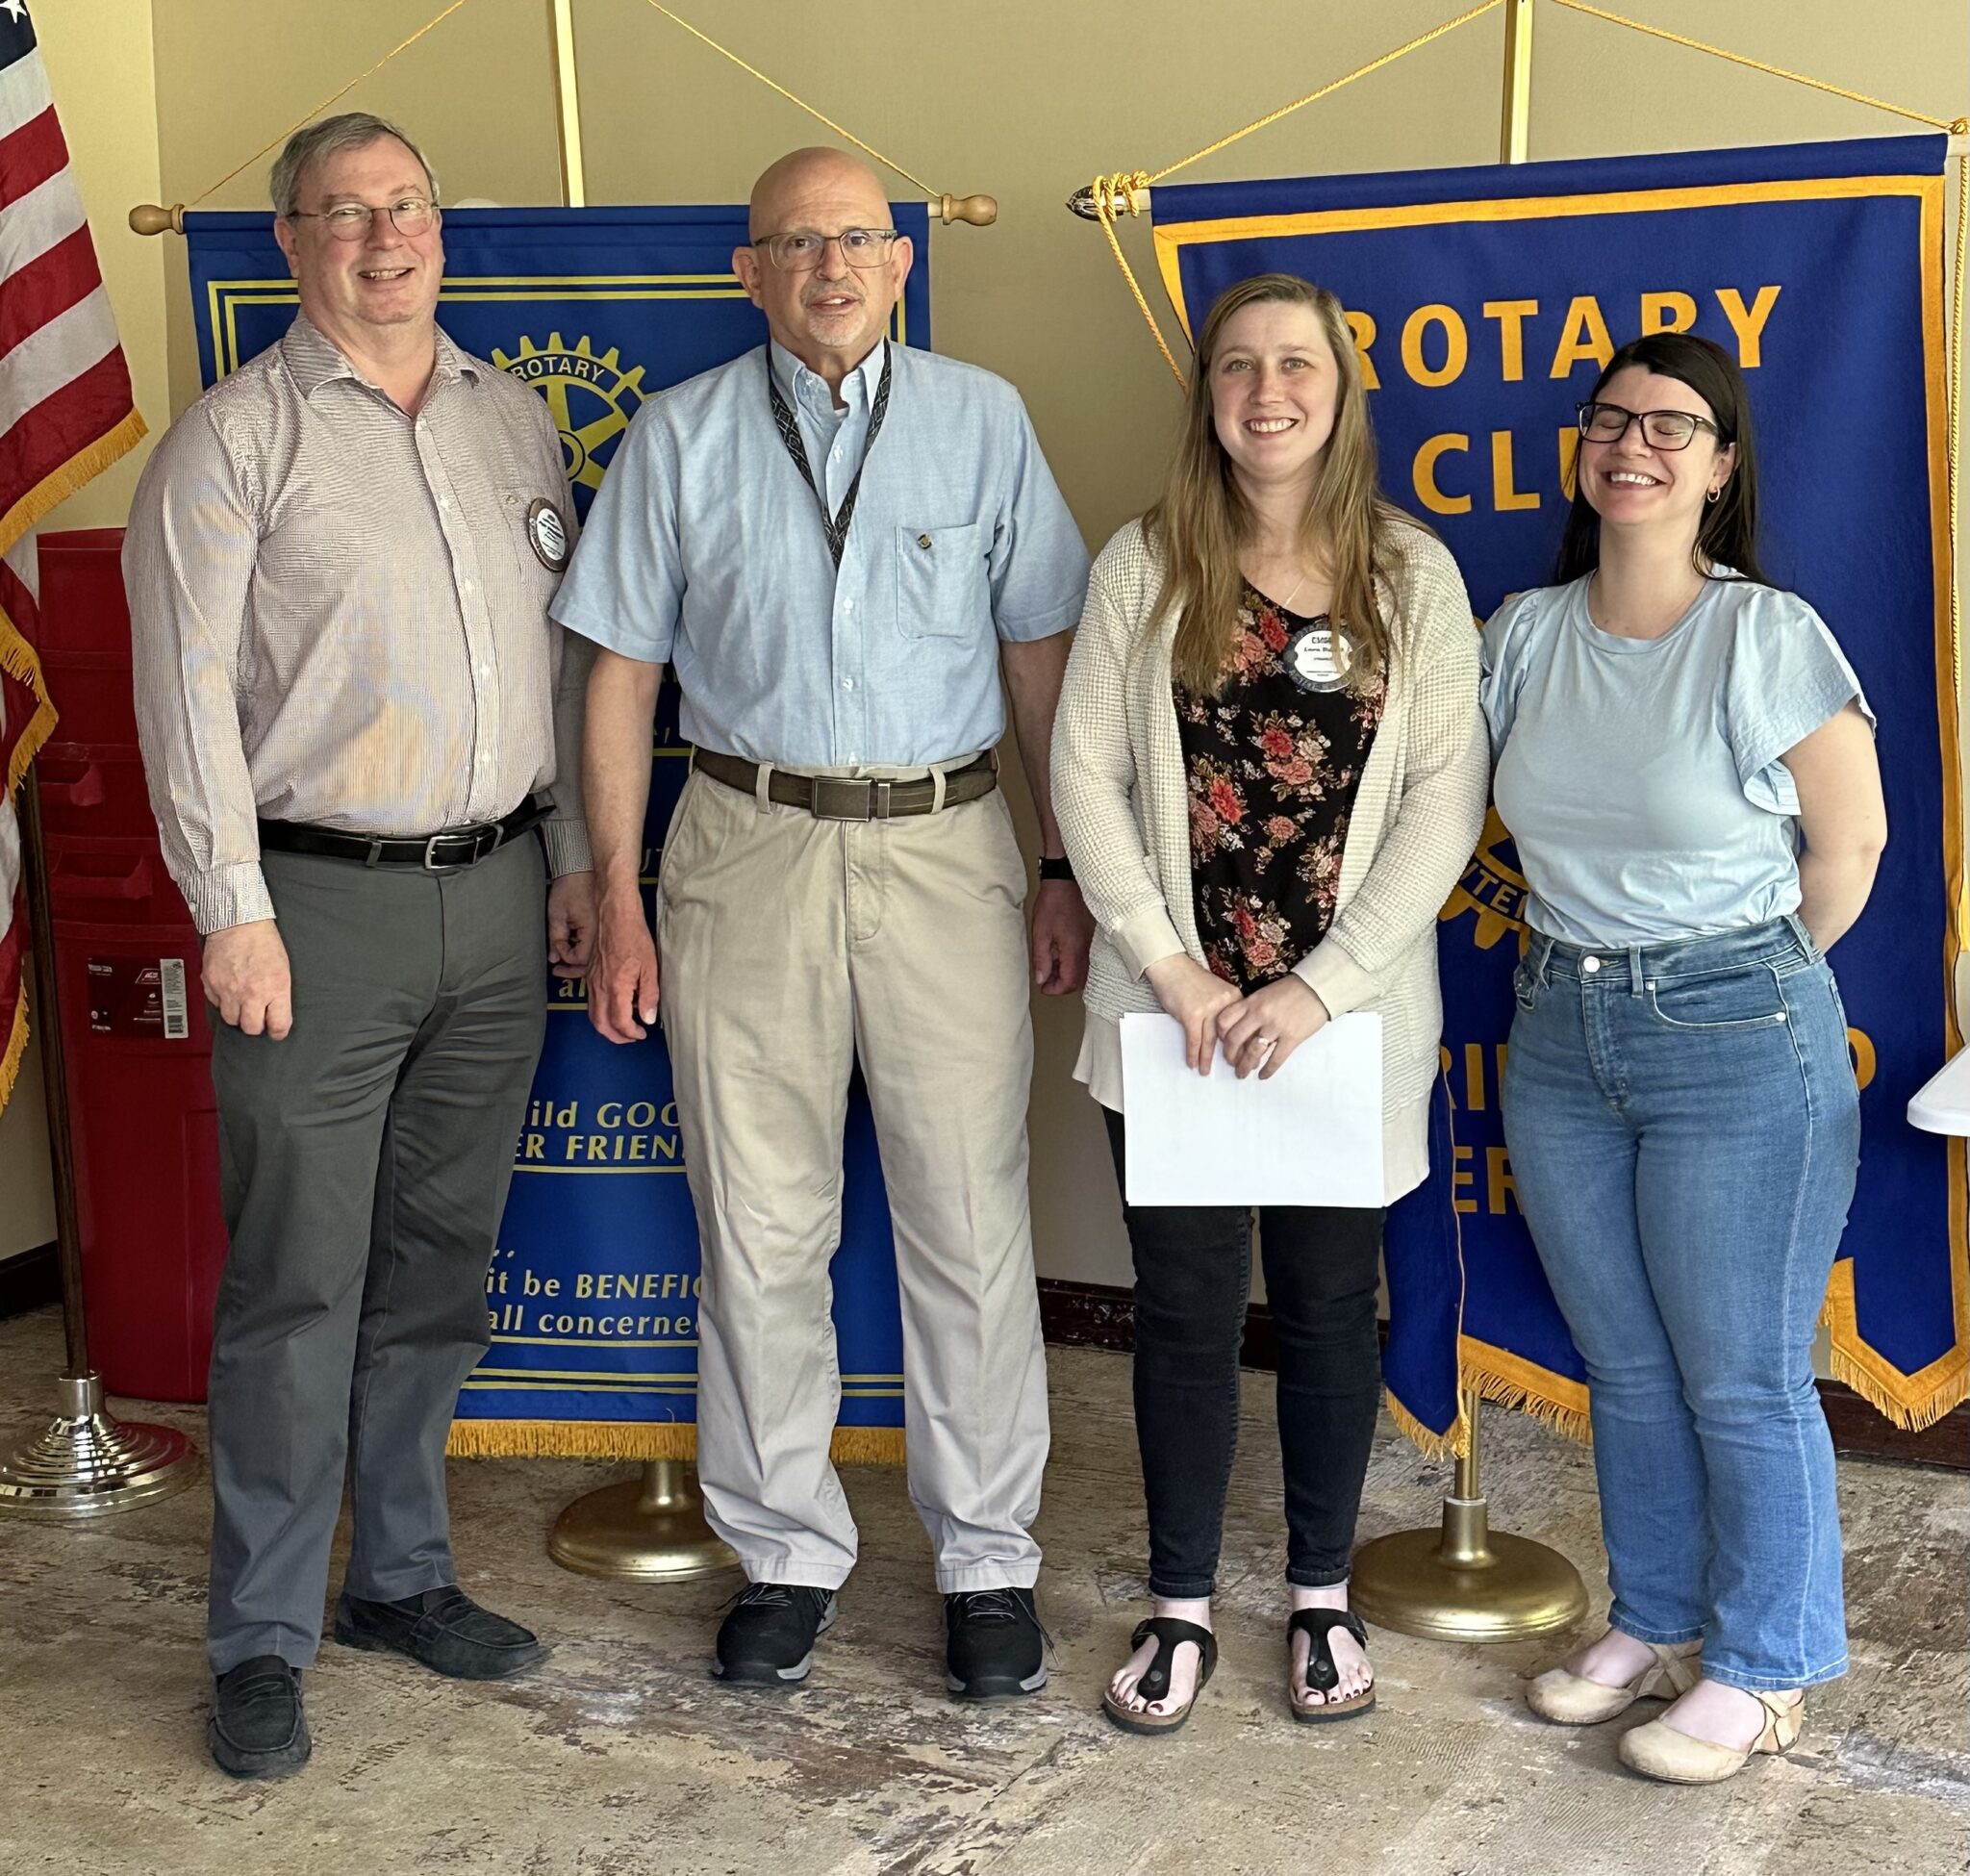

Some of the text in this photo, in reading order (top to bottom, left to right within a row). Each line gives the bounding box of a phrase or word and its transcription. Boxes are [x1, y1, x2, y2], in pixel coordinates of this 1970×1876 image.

[511, 356, 605, 382] ROTARY
[529, 1101, 680, 1128] ild GOO
[566, 1135, 684, 1160] FRIEN
[486, 1268, 701, 1299] it be BENEFI
[538, 1314, 699, 1334] concerne
